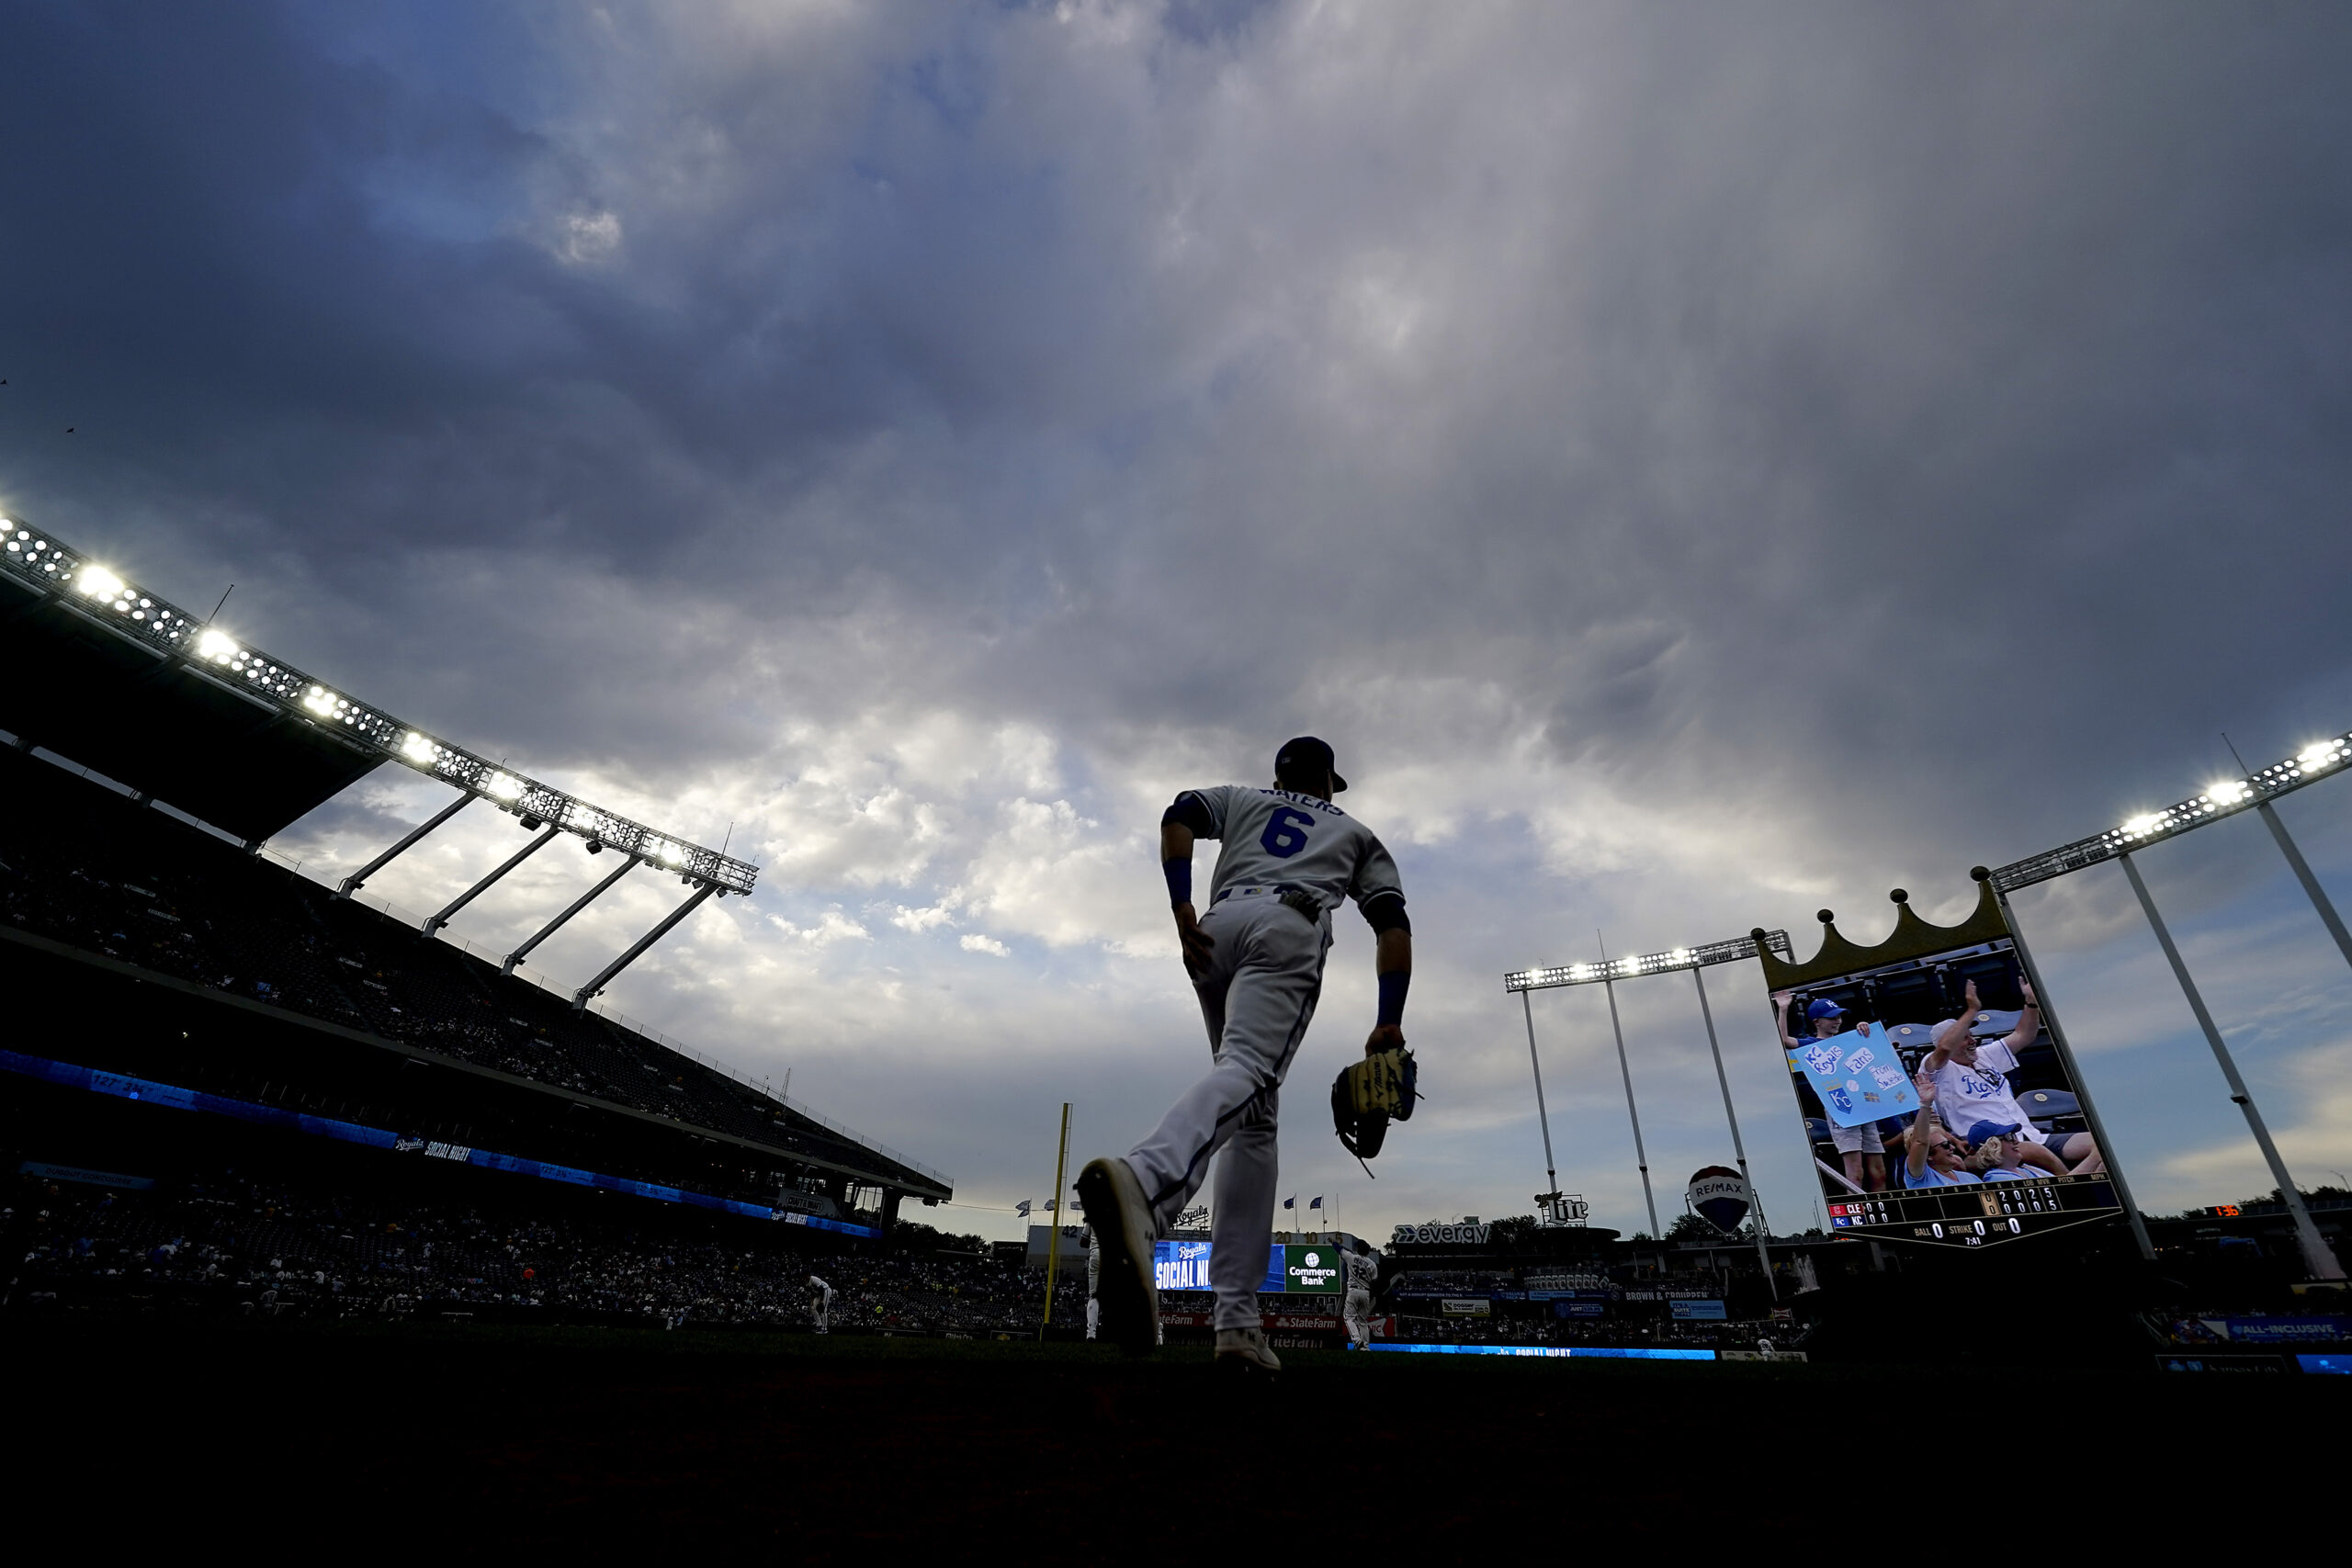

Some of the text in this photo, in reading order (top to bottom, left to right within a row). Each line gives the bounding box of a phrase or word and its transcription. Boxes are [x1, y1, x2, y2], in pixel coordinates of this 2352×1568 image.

[1260, 807, 1316, 859] 6
[1804, 1047, 1822, 1064] KC
[1814, 1047, 1843, 1074] Royals
[1844, 1050, 1873, 1074] Fans
[1830, 1091, 1853, 1108] KC
[395, 1138, 471, 1161] Royals SOCIAL NIGHT
[1696, 1183, 1743, 1197] RE/MAX
[1846, 1203, 1861, 1214] CLE
[1866, 1202, 1872, 1213] 0
[1878, 1201, 1884, 1212] 0
[1985, 1192, 1992, 1202] 0
[1999, 1191, 2007, 1201] 2
[2013, 1190, 2021, 1201] 0
[2029, 1189, 2037, 1200] 2
[2044, 1187, 2052, 1198] 5
[1176, 1205, 1210, 1226] Royals
[1548, 1200, 1589, 1225] Lite
[1851, 1215, 1863, 1225] KC
[1869, 1213, 1876, 1224] 0
[1882, 1213, 1888, 1223] 0
[1989, 1204, 1996, 1214] 0
[2003, 1203, 2011, 1214] 0
[2018, 1202, 2026, 1213] 0
[2033, 1201, 2041, 1212] 0
[2049, 1200, 2057, 1211] 5
[1062, 1225, 1078, 1238] 42
[1276, 1231, 1343, 1244] 20 10 5
[1914, 1217, 2020, 1239] BALL 0 STRIKE 0 OUT 0
[1179, 1243, 1208, 1259] Royals
[1156, 1259, 1194, 1290] SOCIAL
[1289, 1267, 1336, 1277] Commerce
[1301, 1276, 1325, 1286] Bank
[1625, 1292, 1655, 1301] BROWN
[2243, 1324, 2335, 1335] ALL-INCLUSIVE
